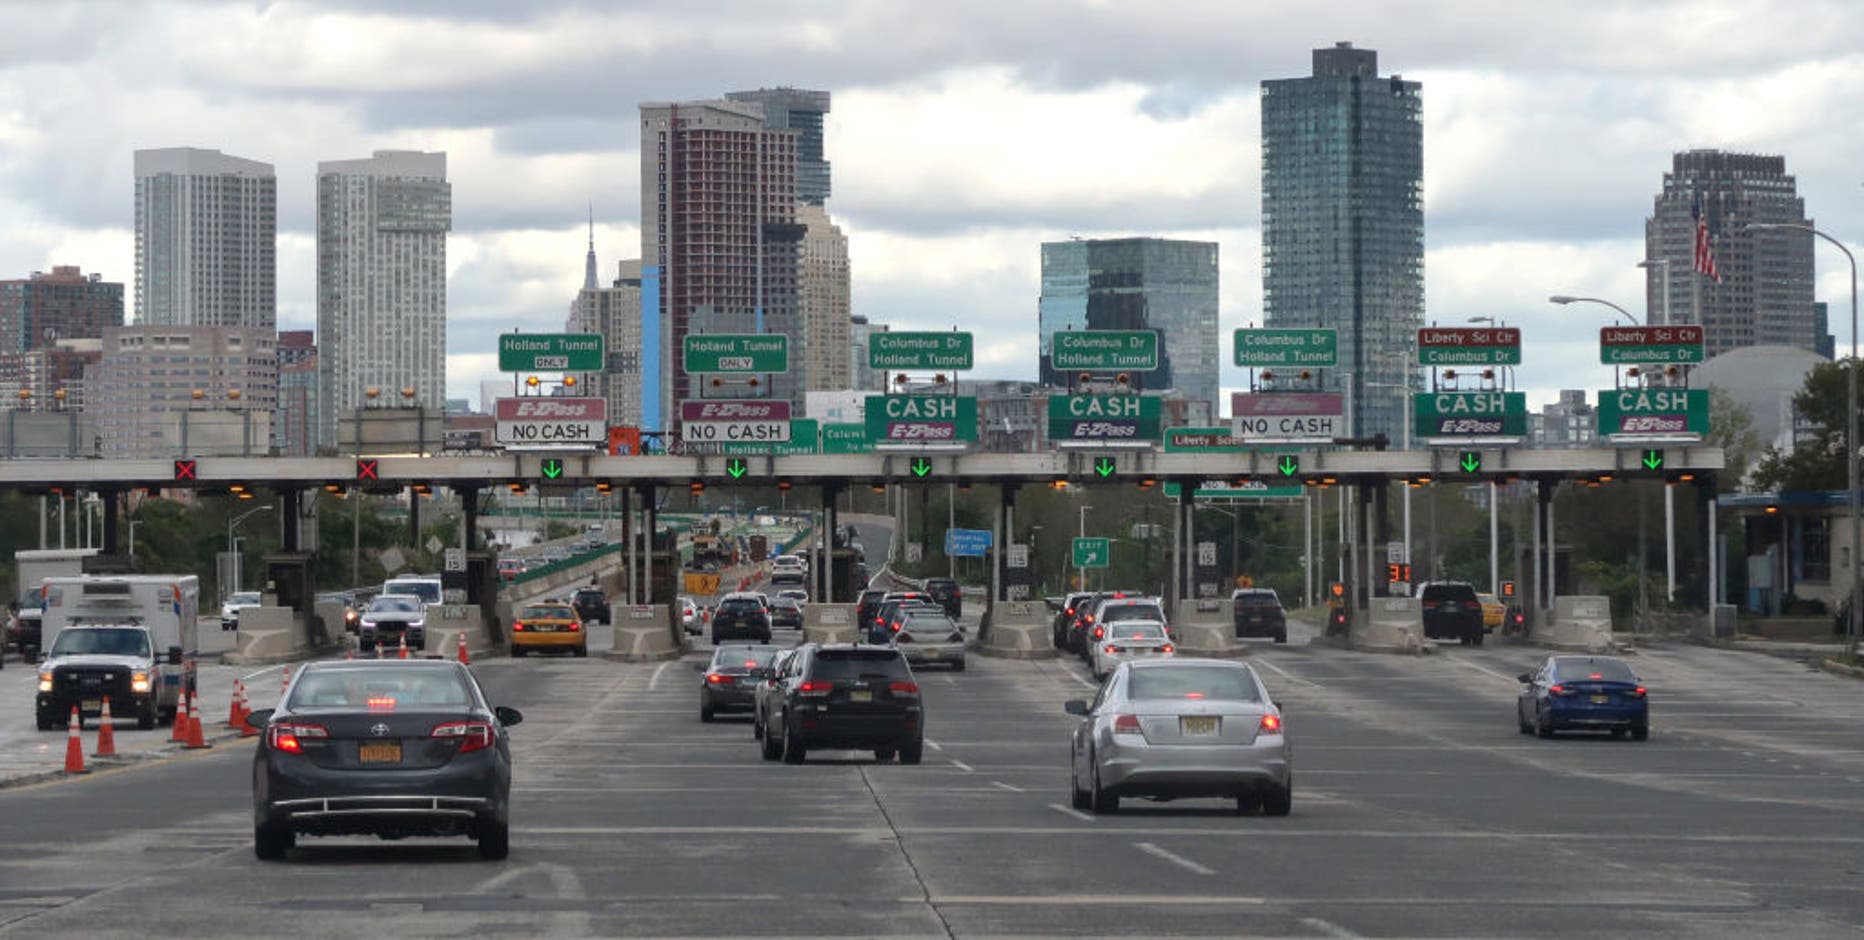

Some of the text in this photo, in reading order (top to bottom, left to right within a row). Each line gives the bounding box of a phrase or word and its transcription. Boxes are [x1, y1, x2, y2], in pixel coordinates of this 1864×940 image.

[1244, 333, 1327, 345] Columbus Dr
[1424, 331, 1513, 344] Liberty Sci Ctr
[1607, 329, 1696, 342] Liberty Sci Ctr
[504, 339, 597, 350] Holland Tunnel
[690, 340, 782, 351] Holland Tunnel
[880, 337, 961, 348] Columbus Dr
[1063, 336, 1144, 348] Columbus Dr
[874, 354, 967, 365] Holland Tunnel
[1058, 353, 1151, 365] Holland Tunnel
[1240, 351, 1333, 361] Holland Tunnel
[1428, 350, 1510, 361] Columbus Dr
[1610, 348, 1692, 360] Columbus Dr
[536, 358, 567, 367] ONLY
[720, 358, 751, 367] ONLY
[1070, 397, 1140, 416] CASH
[1436, 394, 1504, 412] CASH
[1619, 392, 1688, 411] CASH
[886, 398, 957, 418] CASH
[513, 424, 589, 439] NO CASH
[691, 424, 781, 439] NO CASH
[1074, 422, 1136, 436] E-ZPass
[1242, 418, 1332, 433] NO CASH
[1175, 436, 1209, 448] Liberty
[1389, 564, 1410, 582] 31
